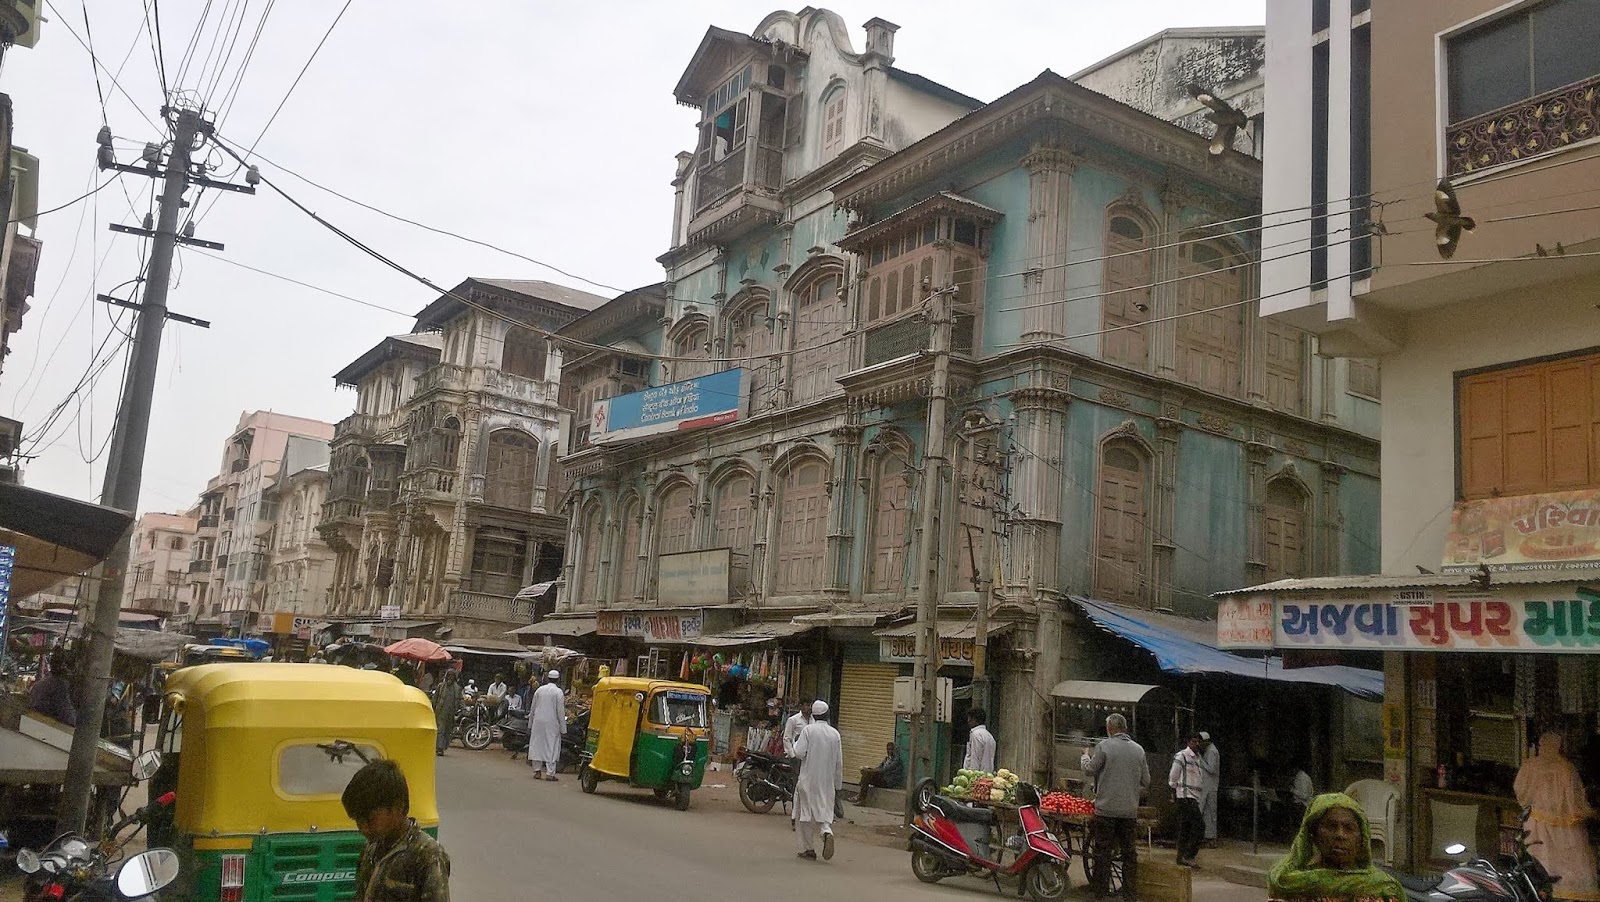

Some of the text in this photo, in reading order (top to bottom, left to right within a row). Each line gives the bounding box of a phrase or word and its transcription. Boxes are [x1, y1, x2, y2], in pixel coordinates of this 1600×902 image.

[1400, 591, 1425, 600] GSTIN
[1281, 603, 1397, 637] અજવા
[1408, 602, 1511, 644] સુપર
[283, 871, 356, 882] Compac
